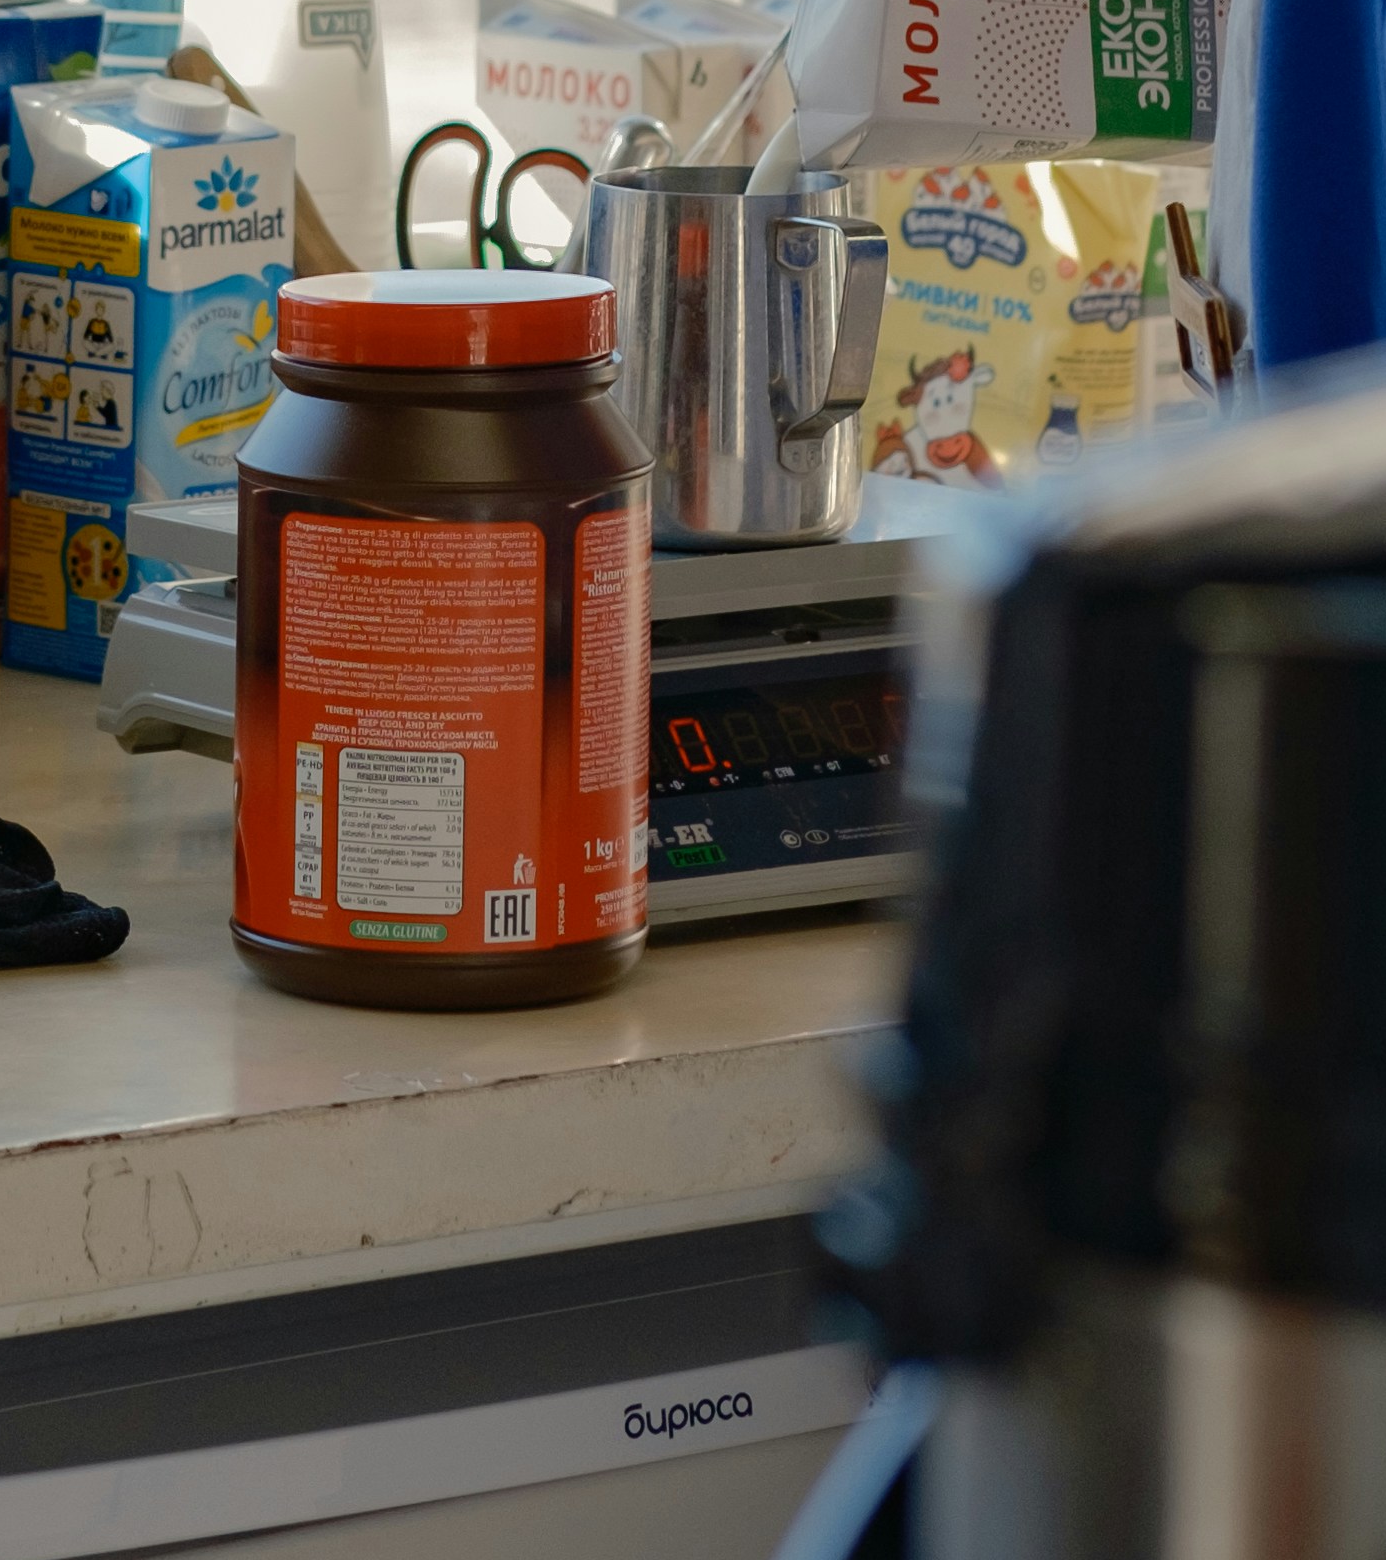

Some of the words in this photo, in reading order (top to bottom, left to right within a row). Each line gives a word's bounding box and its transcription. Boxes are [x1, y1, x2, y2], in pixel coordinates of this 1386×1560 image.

[487, 61, 632, 111] МОЛОКО
[160, 207, 285, 260] parmalat
[993, 296, 1032, 323] 10%
[163, 352, 272, 415] Comfort
[325, 705, 354, 716] TENERE
[397, 709, 430, 720] FRESCO
[439, 711, 483, 721] ASCIUTTO
[358, 718, 378, 728] KEEP
[380, 719, 403, 729] COOL
[404, 720, 425, 730] AND
[426, 721, 445, 730] DRY
[297, 758, 323, 770] PE-HD
[373, 763, 406, 772] NUTRITION
[407, 765, 425, 773] FACTS
[426, 766, 438, 774] PER
[427, 756, 439, 764] PER
[303, 811, 314, 821] PP
[584, 840, 591, 861] 1
[596, 837, 614, 861] kg
[297, 861, 319, 872] C/PAP
[489, 894, 531, 940] EAC
[355, 922, 389, 938] SENZA
[392, 924, 440, 940] GLUTINE
[624, 1391, 753, 1440] бирюса
